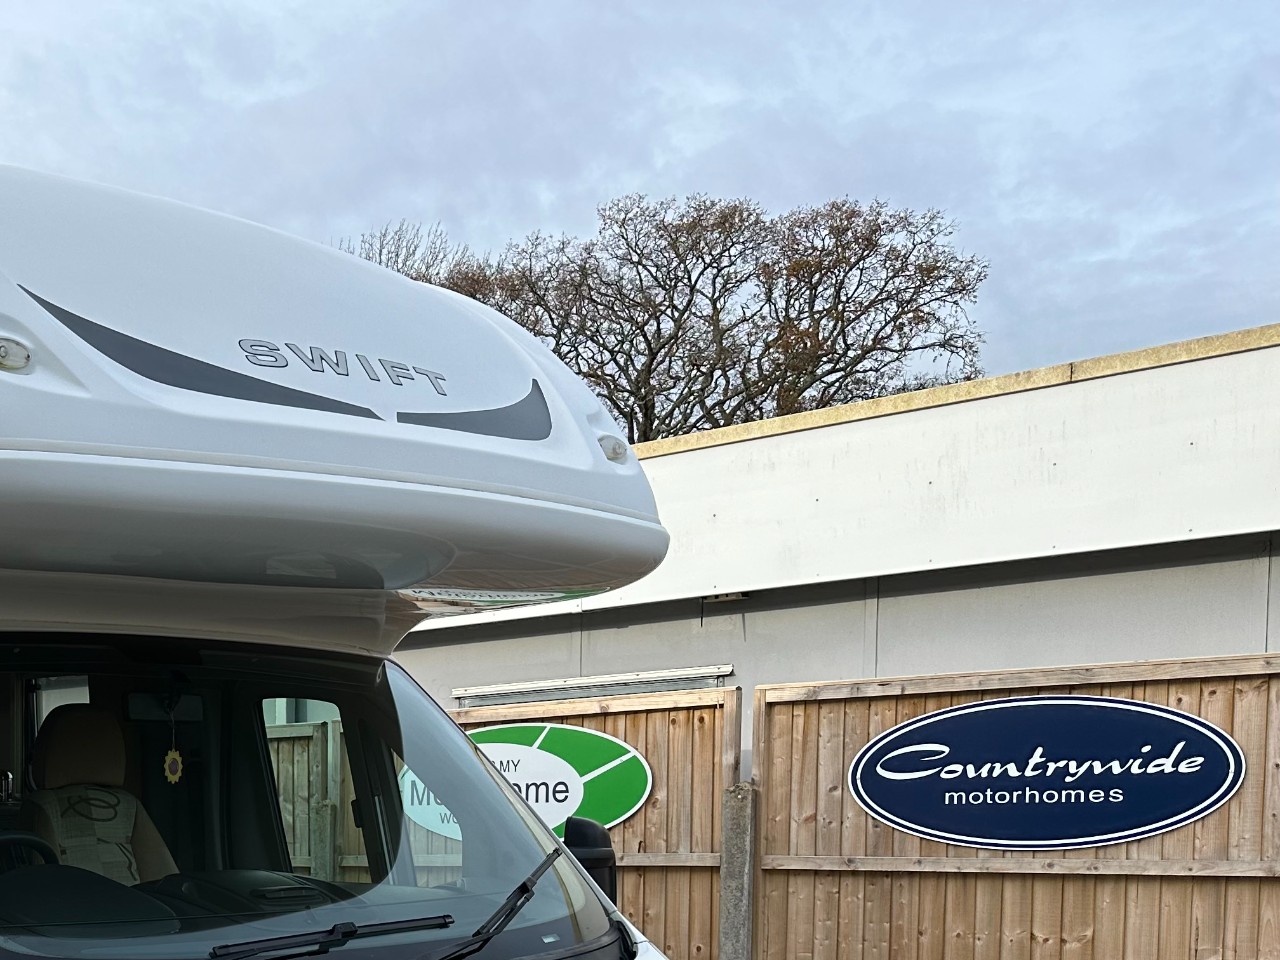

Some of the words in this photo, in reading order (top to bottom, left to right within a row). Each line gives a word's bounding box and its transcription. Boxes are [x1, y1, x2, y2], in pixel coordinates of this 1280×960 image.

[238, 338, 448, 397] SWIFT
[499, 759, 521, 773] MY
[875, 740, 1205, 783] Countrywide
[944, 786, 1124, 806] motorhomes
